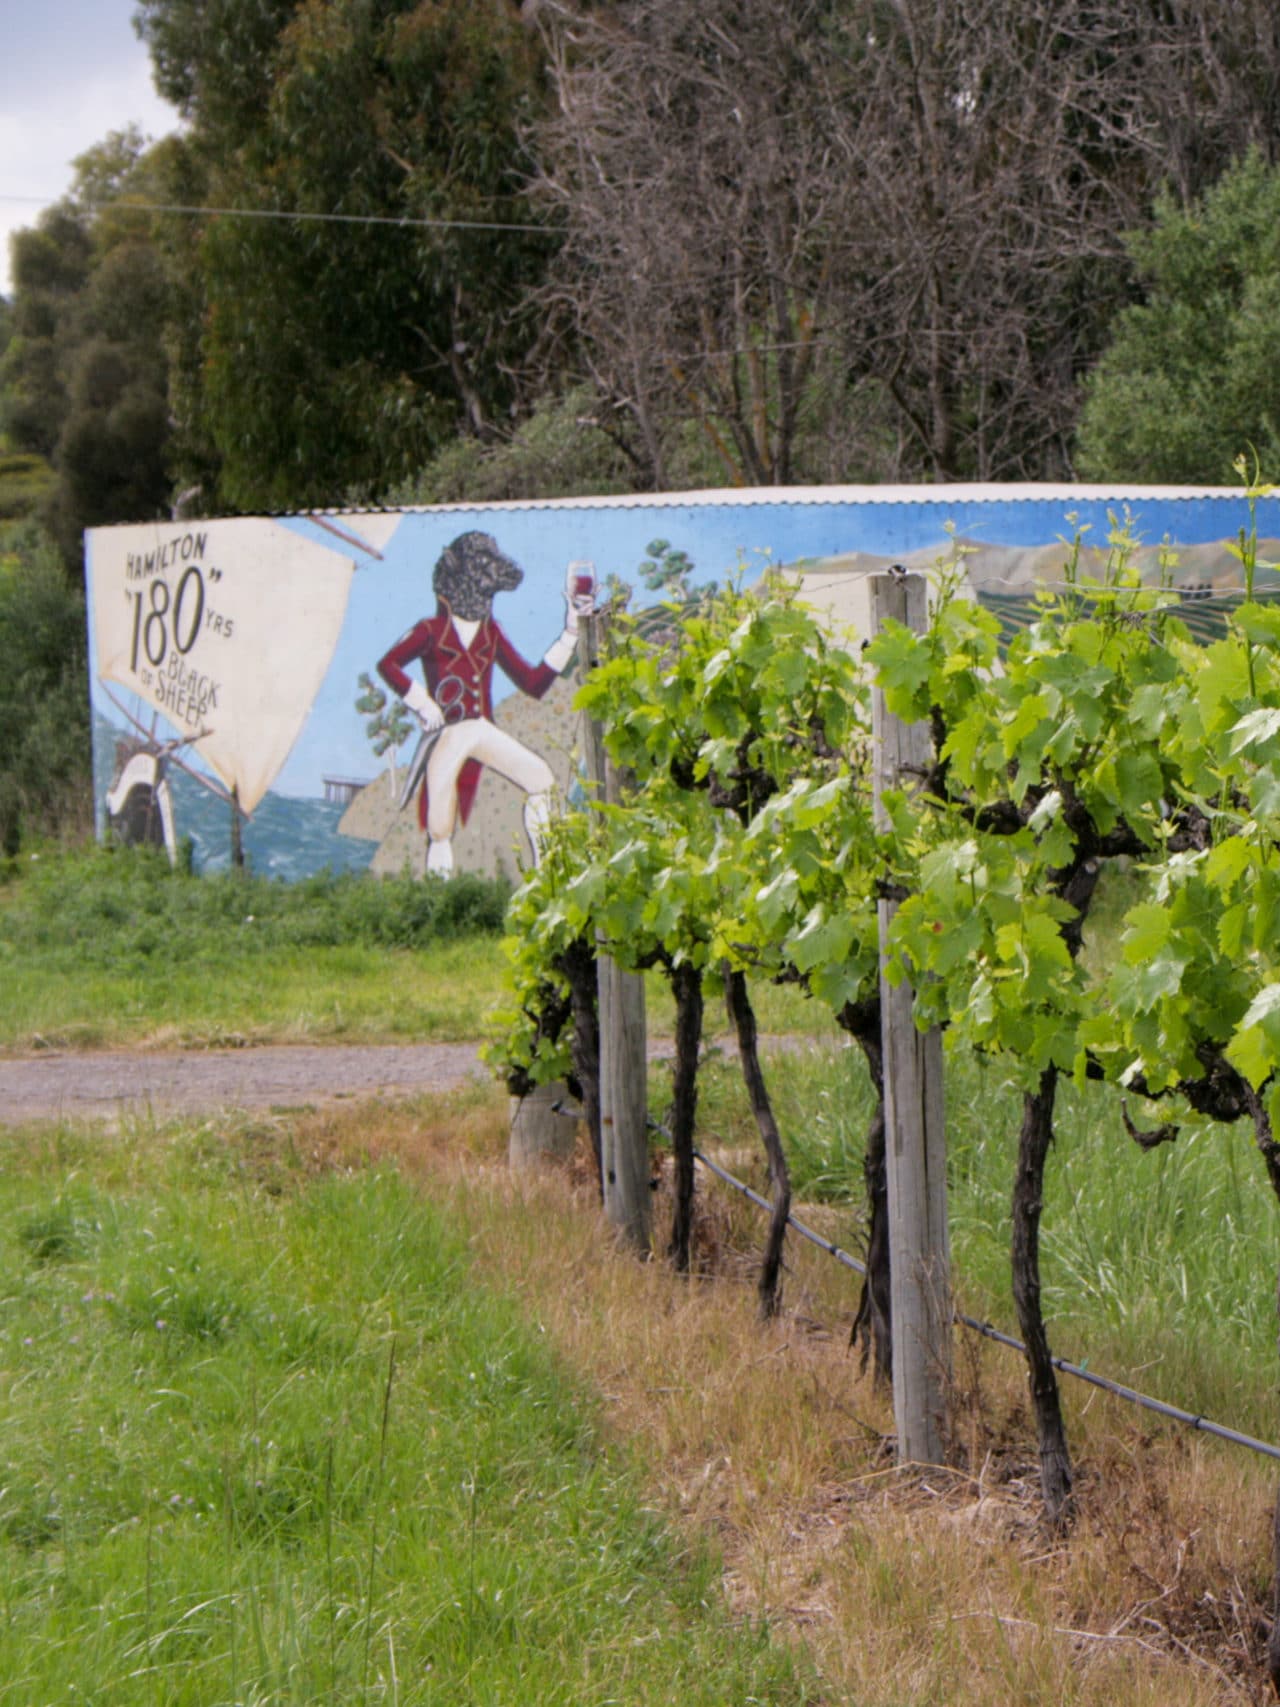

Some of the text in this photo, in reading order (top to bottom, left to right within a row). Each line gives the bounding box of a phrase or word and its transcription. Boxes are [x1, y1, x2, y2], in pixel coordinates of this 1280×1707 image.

[126, 532, 208, 581] HAMILTON
[205, 608, 234, 638] YRS
[155, 670, 209, 728] SHEEP
[167, 651, 222, 708] BLACK
